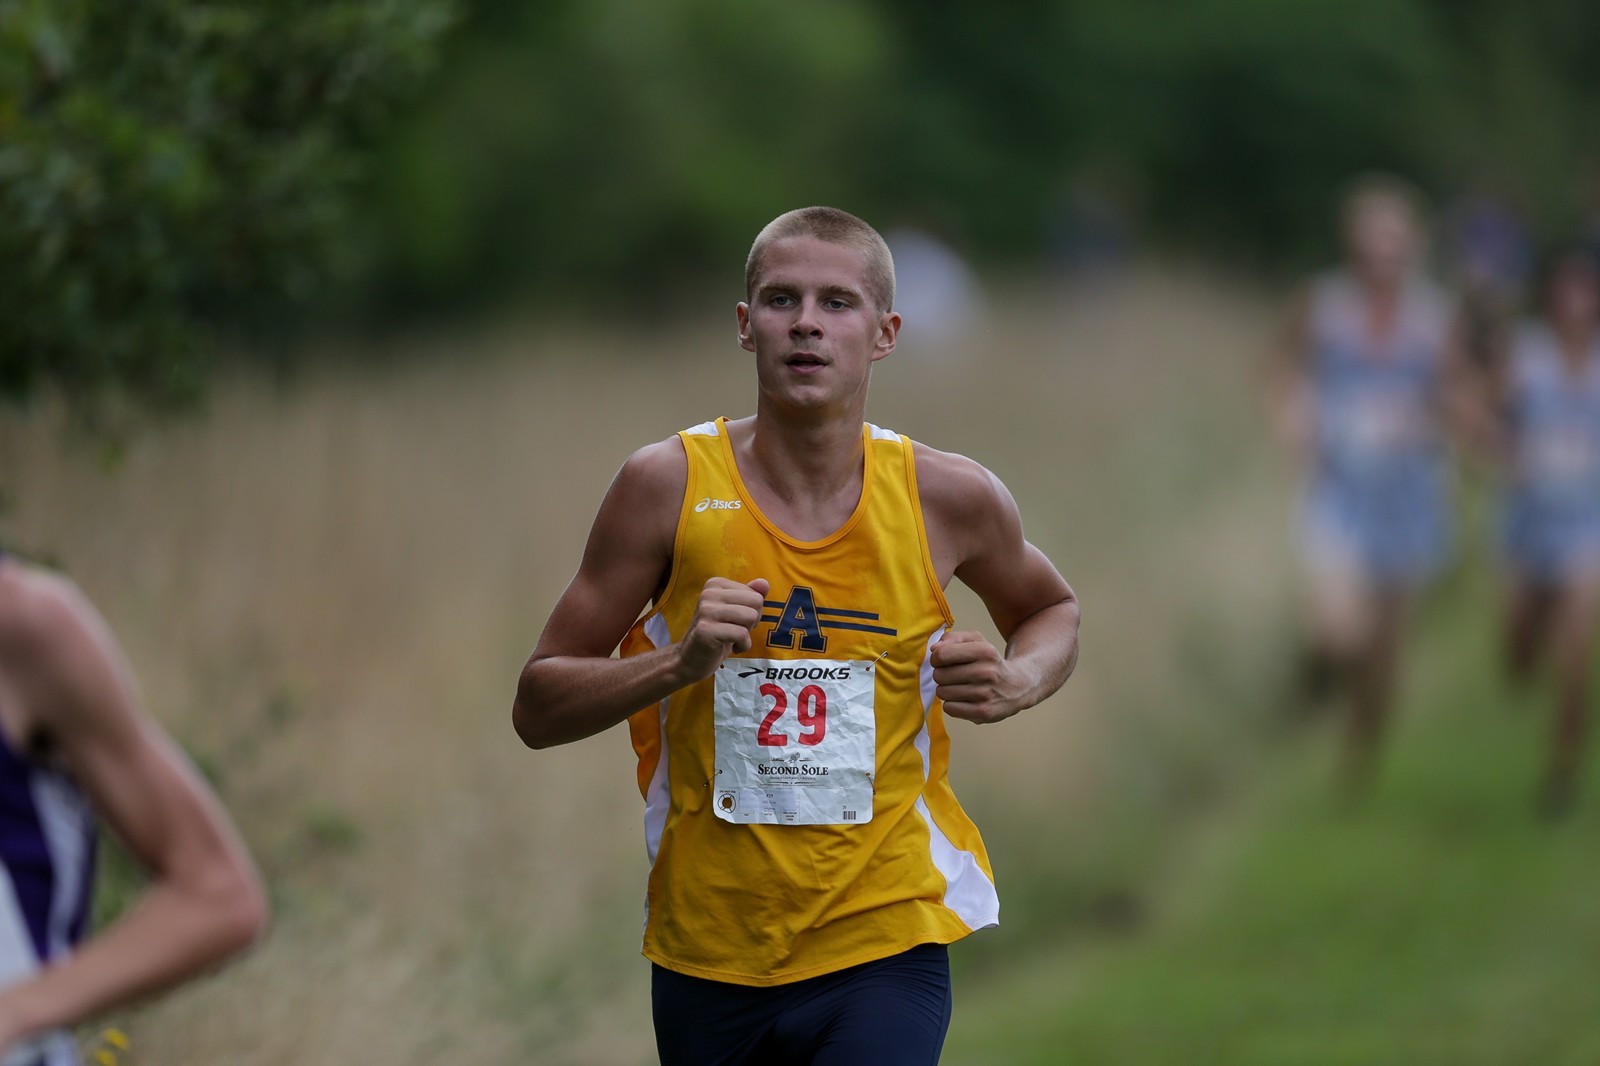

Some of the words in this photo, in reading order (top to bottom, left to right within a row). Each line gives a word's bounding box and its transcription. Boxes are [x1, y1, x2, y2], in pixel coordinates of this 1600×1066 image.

[710, 499, 741, 510] asics
[766, 585, 828, 653] A
[765, 667, 850, 680] BROOKS
[757, 682, 827, 747] 29
[757, 763, 799, 775] SECOND
[801, 764, 829, 776] SOLE
